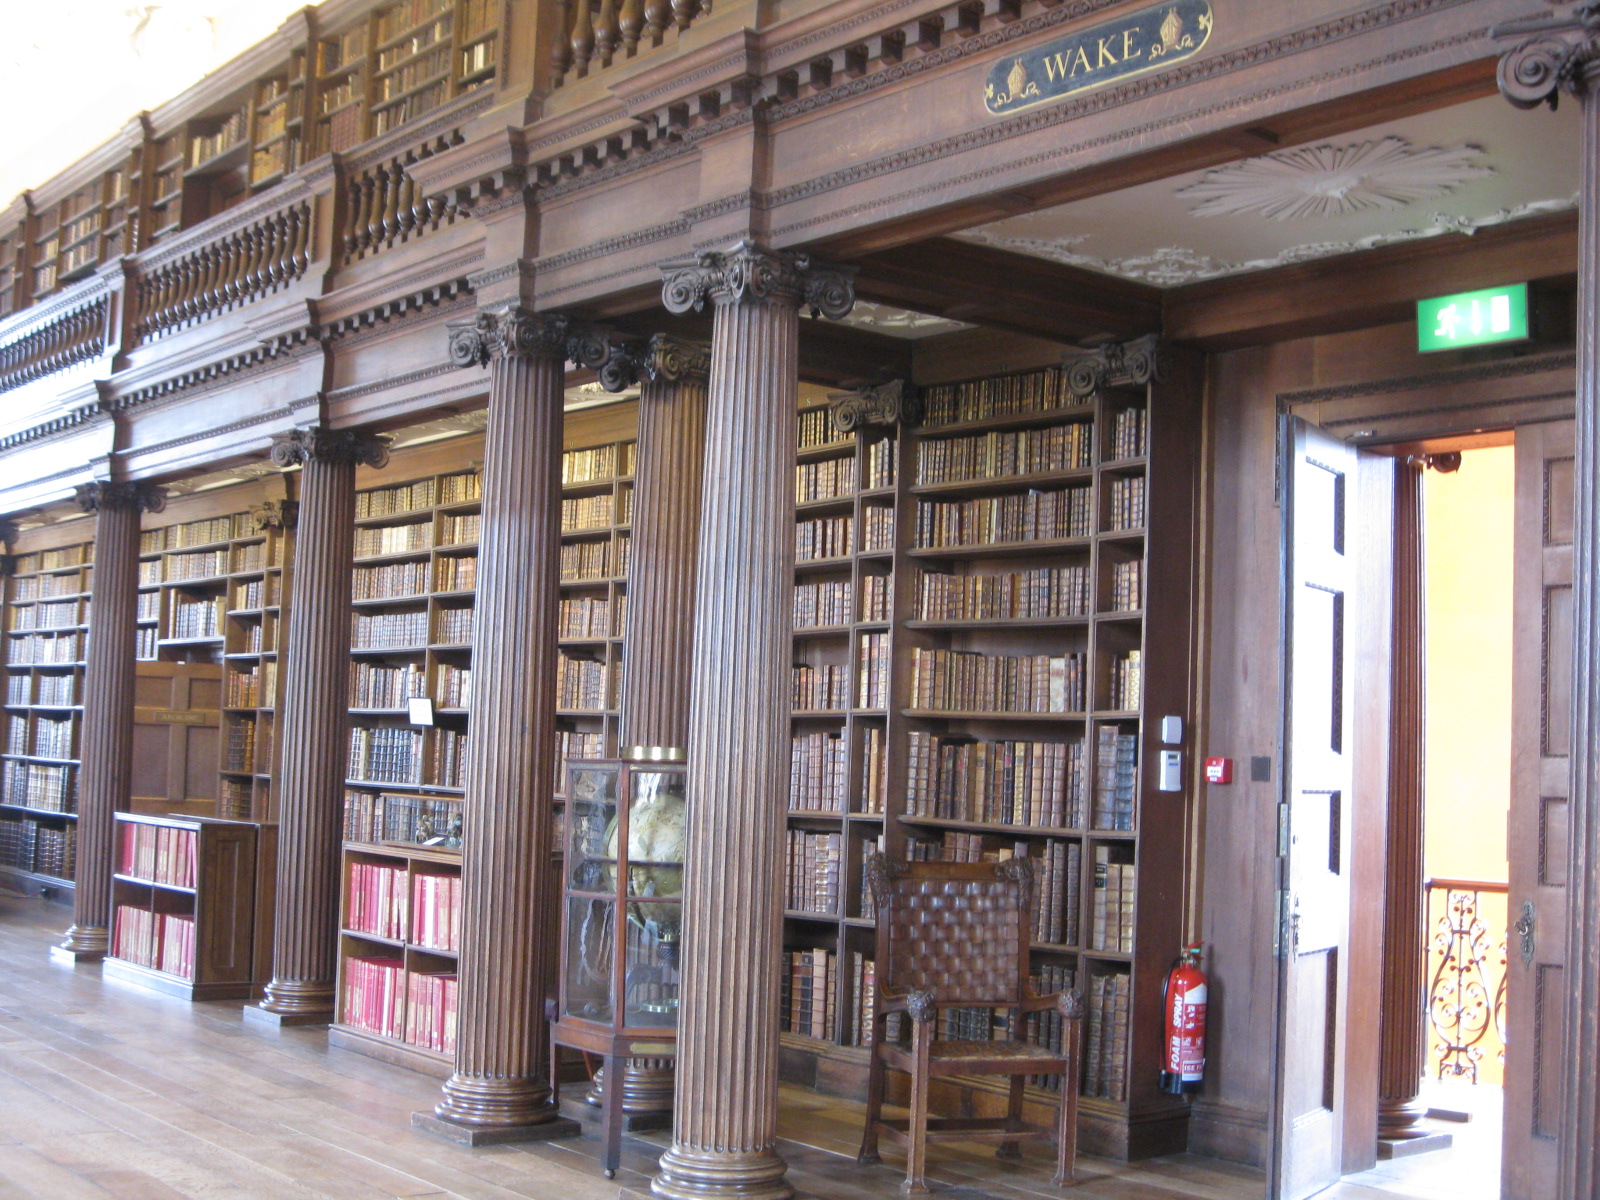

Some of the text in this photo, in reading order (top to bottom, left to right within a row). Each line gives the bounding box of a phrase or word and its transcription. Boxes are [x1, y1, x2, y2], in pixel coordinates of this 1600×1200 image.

[1043, 27, 1141, 83] WAKE
[1171, 993, 1183, 1071] FOAM SPRAY
